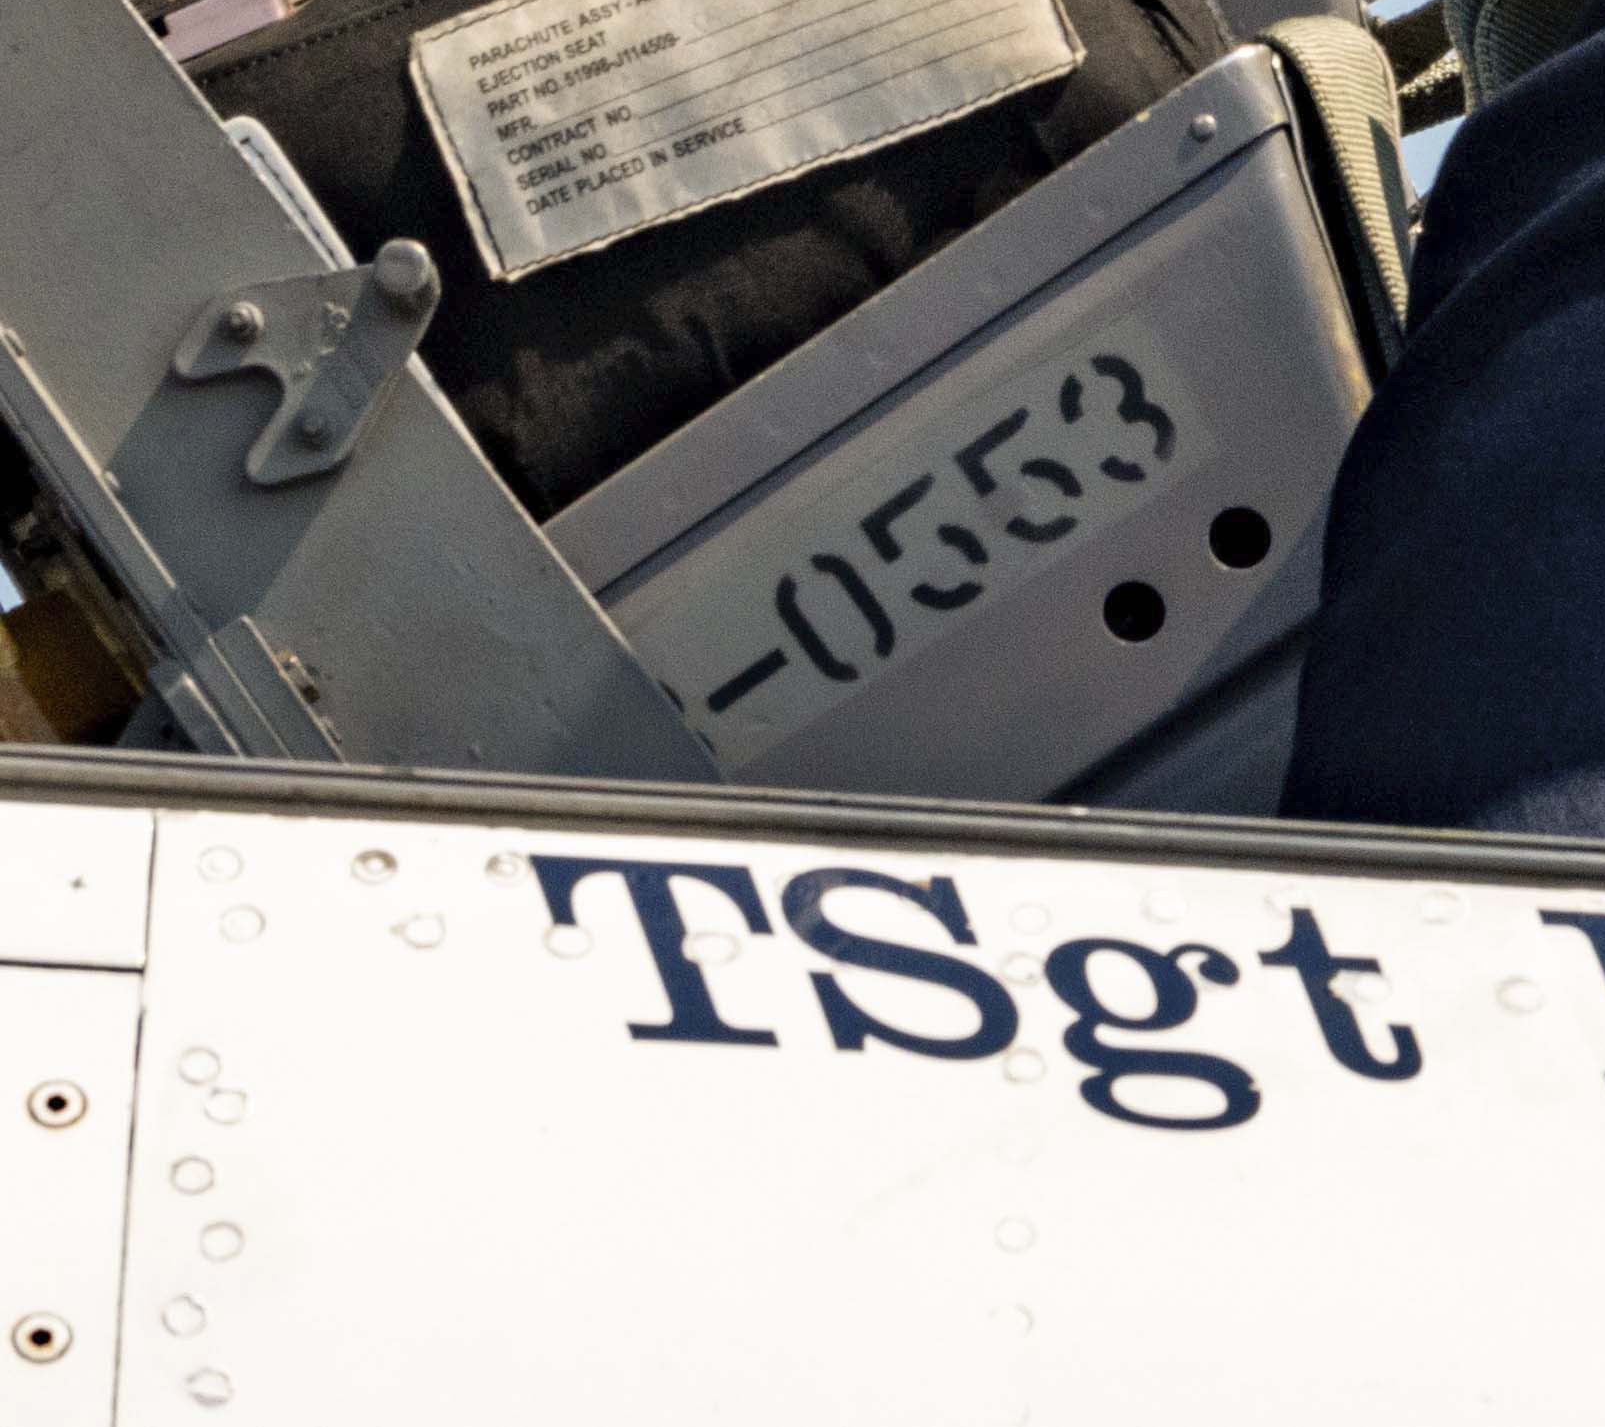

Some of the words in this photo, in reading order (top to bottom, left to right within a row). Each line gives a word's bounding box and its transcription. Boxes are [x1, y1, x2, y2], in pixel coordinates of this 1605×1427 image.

[469, 21, 571, 71] PARACHUTE
[579, 1, 622, 28] ASSY
[477, 51, 561, 94] EJECTION
[565, 31, 608, 60] SEAT
[487, 89, 529, 118] PART
[507, 117, 597, 165] CONTRACT
[516, 157, 576, 191] SERIAL
[527, 189, 572, 216] DATE
[577, 157, 645, 194] PLACED
[651, 149, 669, 168] IN
[673, 117, 746, 158] SERVICE
[658, 354, 1177, 754] -0553
[529, 854, 1423, 1132] TSgt
